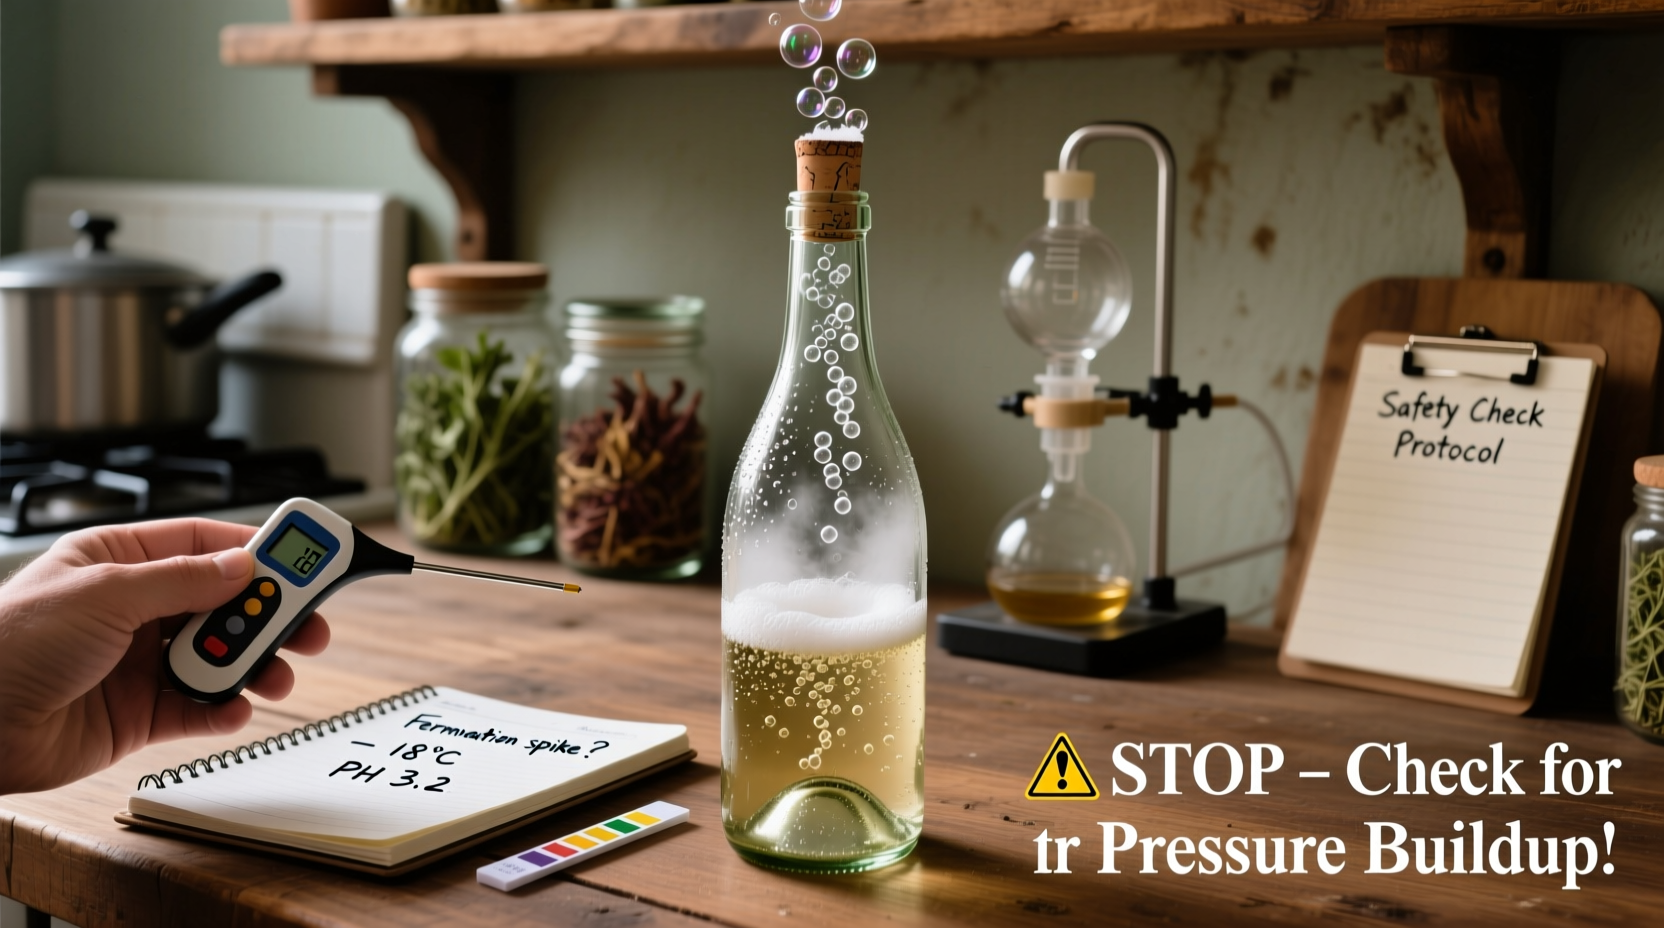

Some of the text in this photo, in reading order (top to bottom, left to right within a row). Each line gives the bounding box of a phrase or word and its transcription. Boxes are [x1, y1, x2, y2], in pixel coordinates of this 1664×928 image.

[1378, 390, 1545, 430] Safety Check
[1393, 429, 1505, 465] Protocol
[389, 769, 451, 793] 3.2
